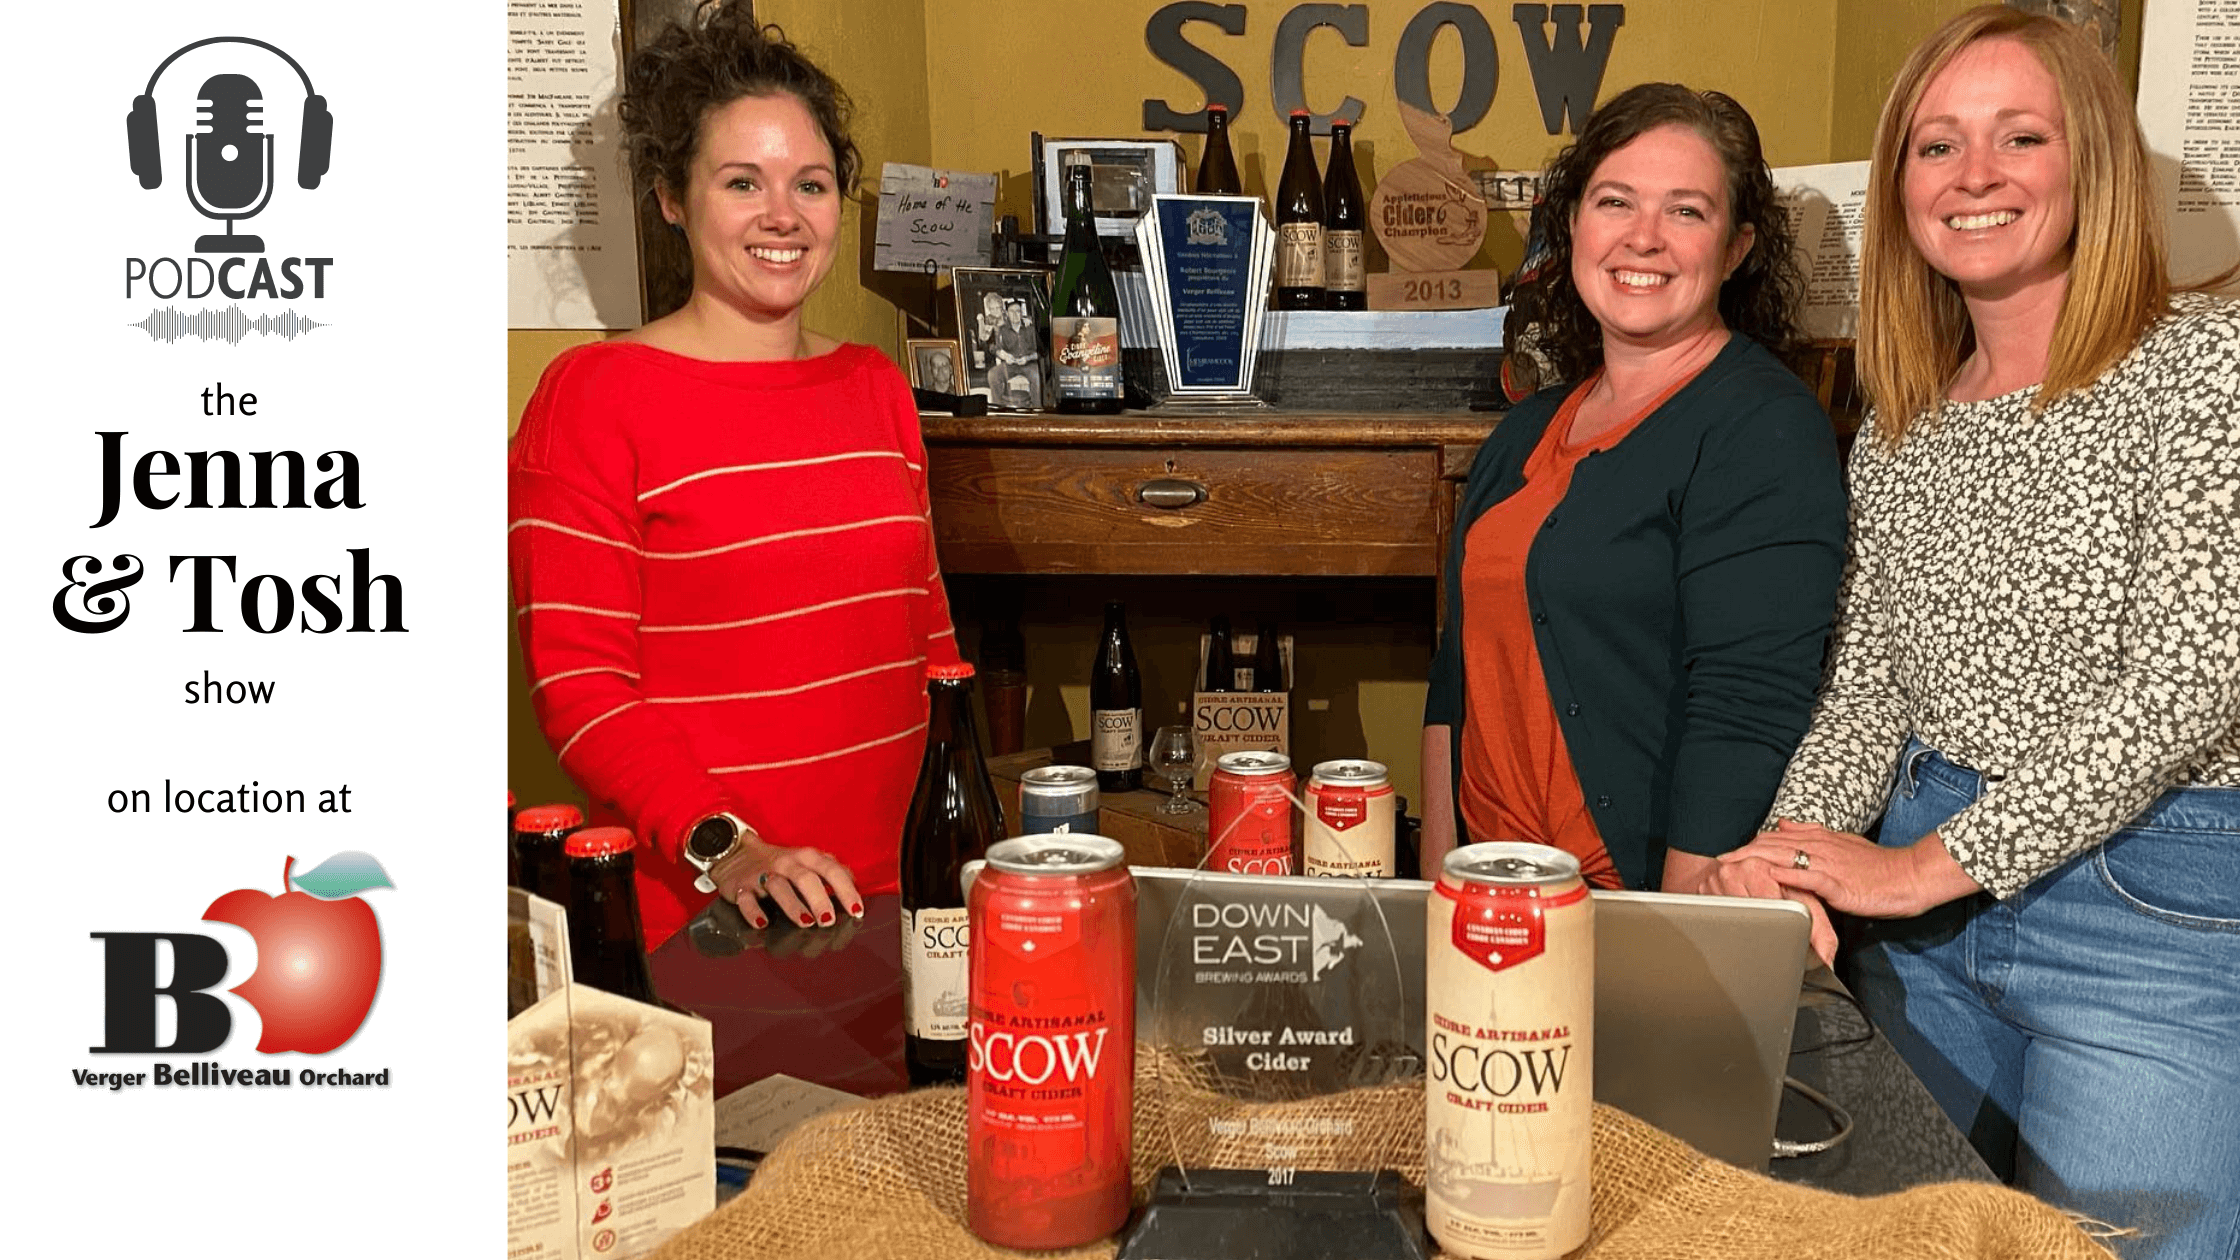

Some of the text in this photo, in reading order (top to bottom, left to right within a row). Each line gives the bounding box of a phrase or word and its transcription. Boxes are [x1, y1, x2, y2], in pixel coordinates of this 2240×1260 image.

[1143, 2, 1625, 136] SCOW
[898, 194, 927, 214] Home
[936, 196, 951, 211] of
[1383, 204, 1435, 226] Cider
[909, 219, 955, 234] Scow
[1283, 229, 1317, 242] SCOW
[1384, 226, 1448, 238] Champion
[1328, 237, 1359, 249] SCOW
[1404, 278, 1462, 302] 2013
[1098, 716, 1133, 729] SCOW
[1197, 705, 1284, 731] SCOW
[1242, 734, 1282, 742] CIDER
[1193, 903, 1310, 929] DOWN
[926, 951, 963, 959] CRAFT
[1194, 935, 1309, 964] EAST
[1195, 971, 1309, 984] BREWING AWARDS
[1009, 1011, 1106, 1029] ARTISANAL
[1433, 1012, 1570, 1043] CIDRE ARTISANAL
[1203, 1026, 1354, 1046] Silver Award
[970, 1022, 1108, 1085] SCOW
[1246, 1052, 1311, 1072] Cider
[1432, 1032, 1572, 1098] SCOW
[1446, 1091, 1549, 1114] CRAFT CIDER
[1267, 1167, 1296, 1186] 2017
